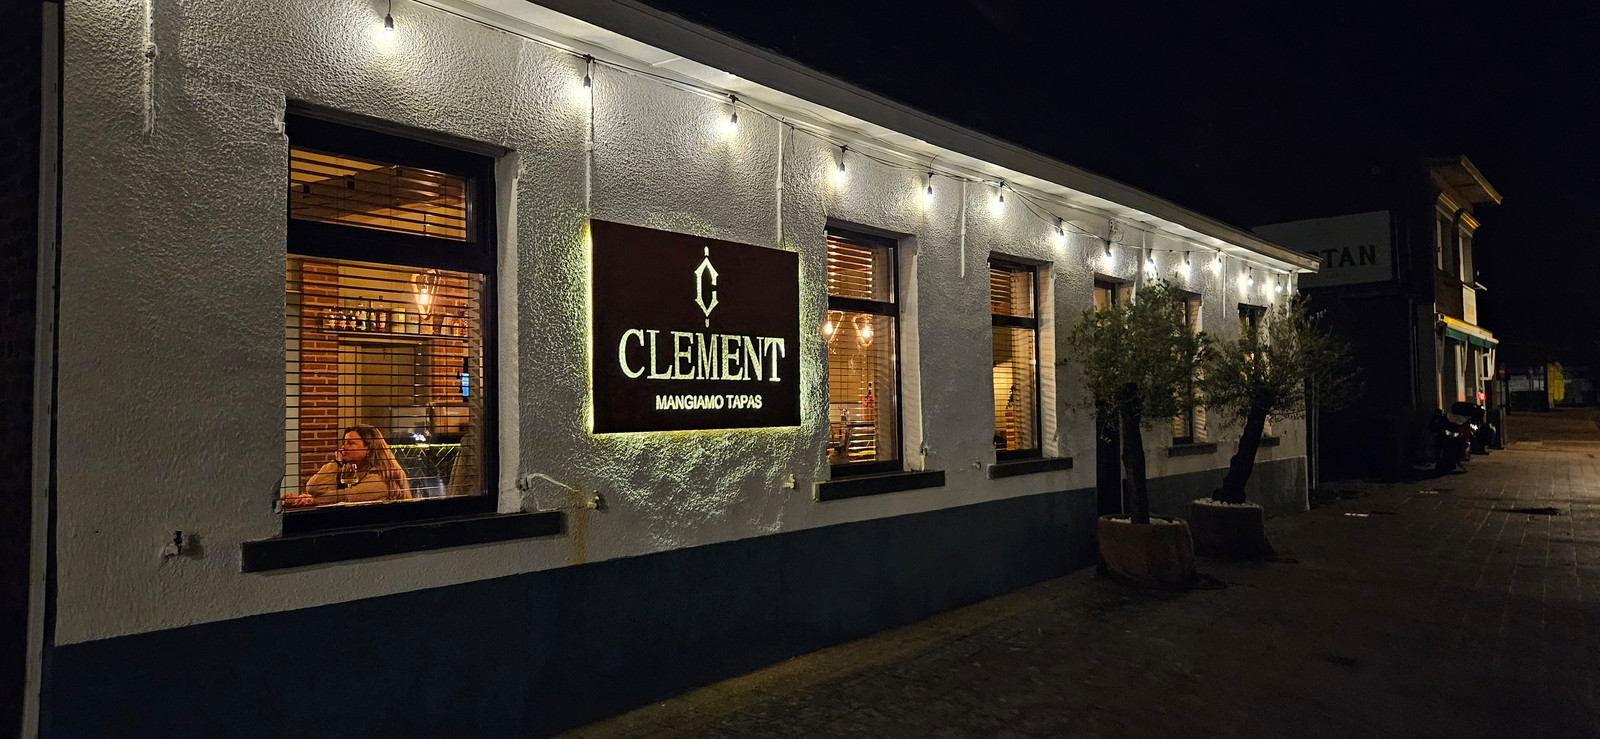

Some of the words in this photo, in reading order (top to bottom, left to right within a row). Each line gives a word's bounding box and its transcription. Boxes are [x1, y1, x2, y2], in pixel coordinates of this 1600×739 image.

[1304, 244, 1376, 268] TAN
[618, 328, 785, 382] CLEMENT
[655, 394, 724, 410] MANGIAMO
[726, 394, 763, 409] TAPAS
